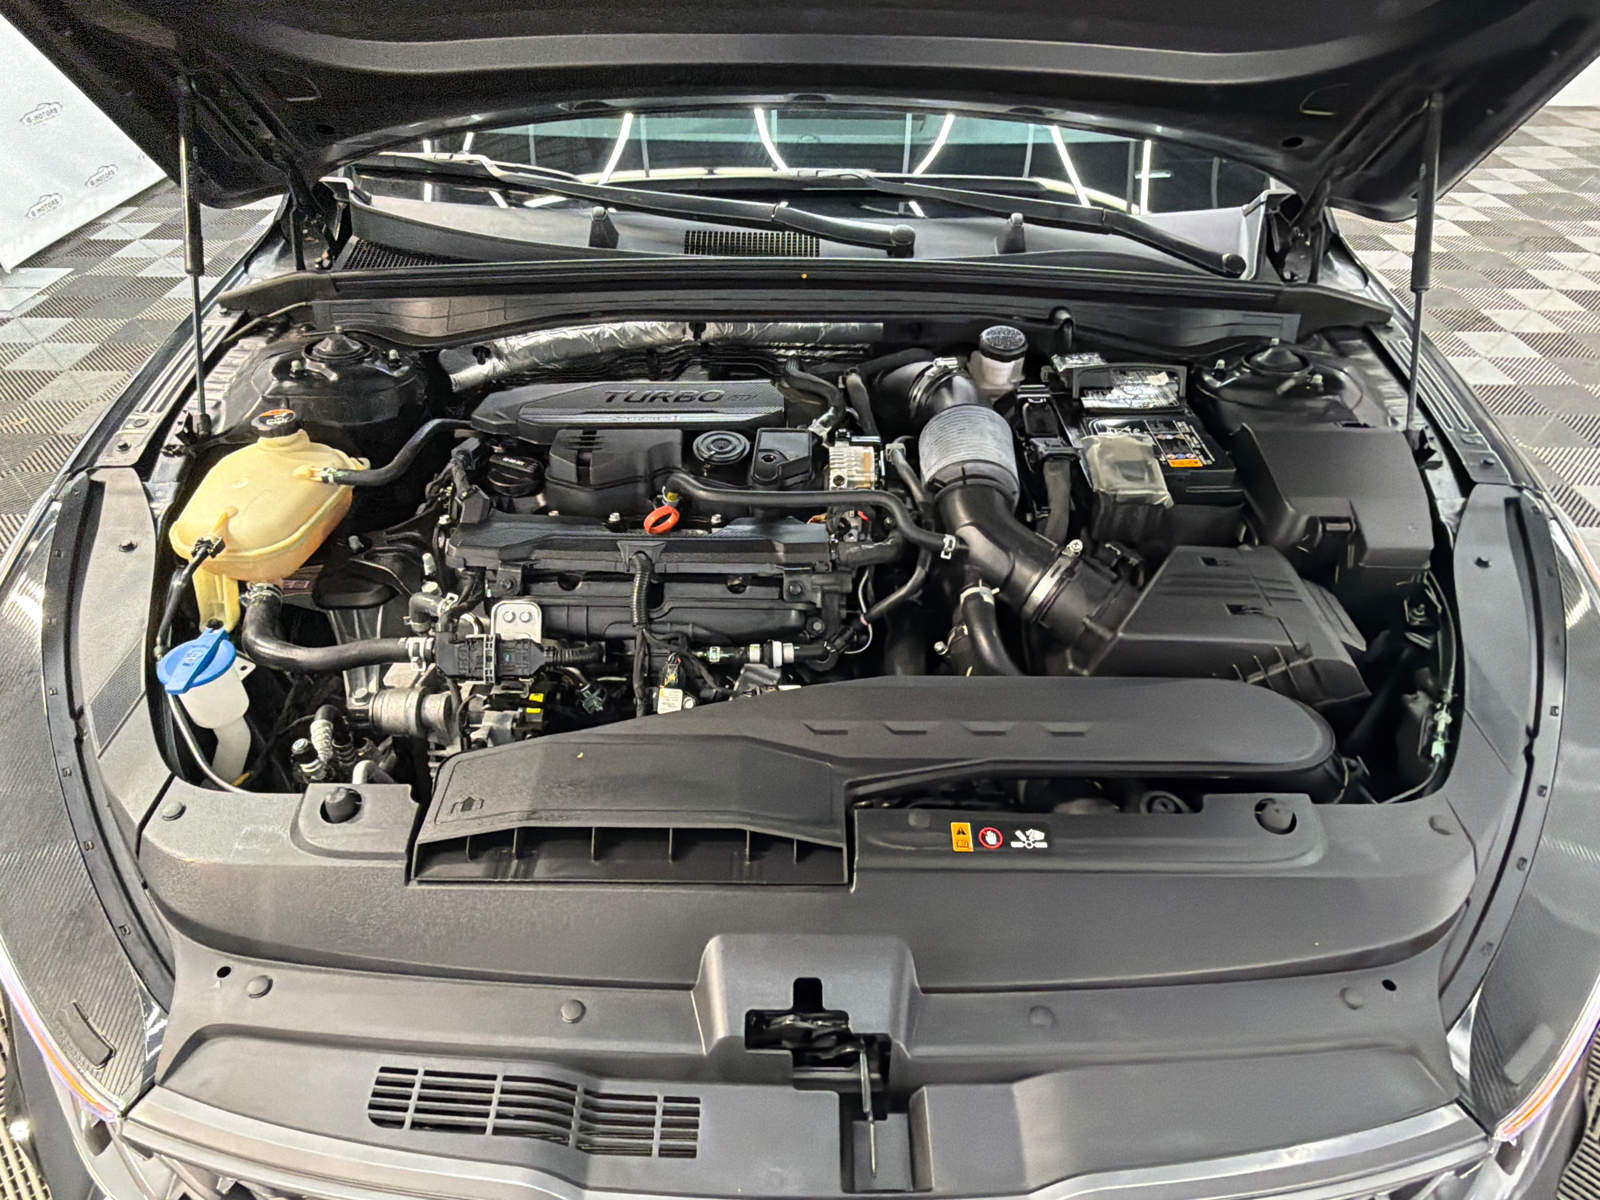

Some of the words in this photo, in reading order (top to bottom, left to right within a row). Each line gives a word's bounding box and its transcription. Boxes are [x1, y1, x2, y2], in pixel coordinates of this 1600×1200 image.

[33, 107, 58, 121] MOTORS
[36, 198, 59, 214] MOTORS
[604, 389, 726, 404] TURBO
